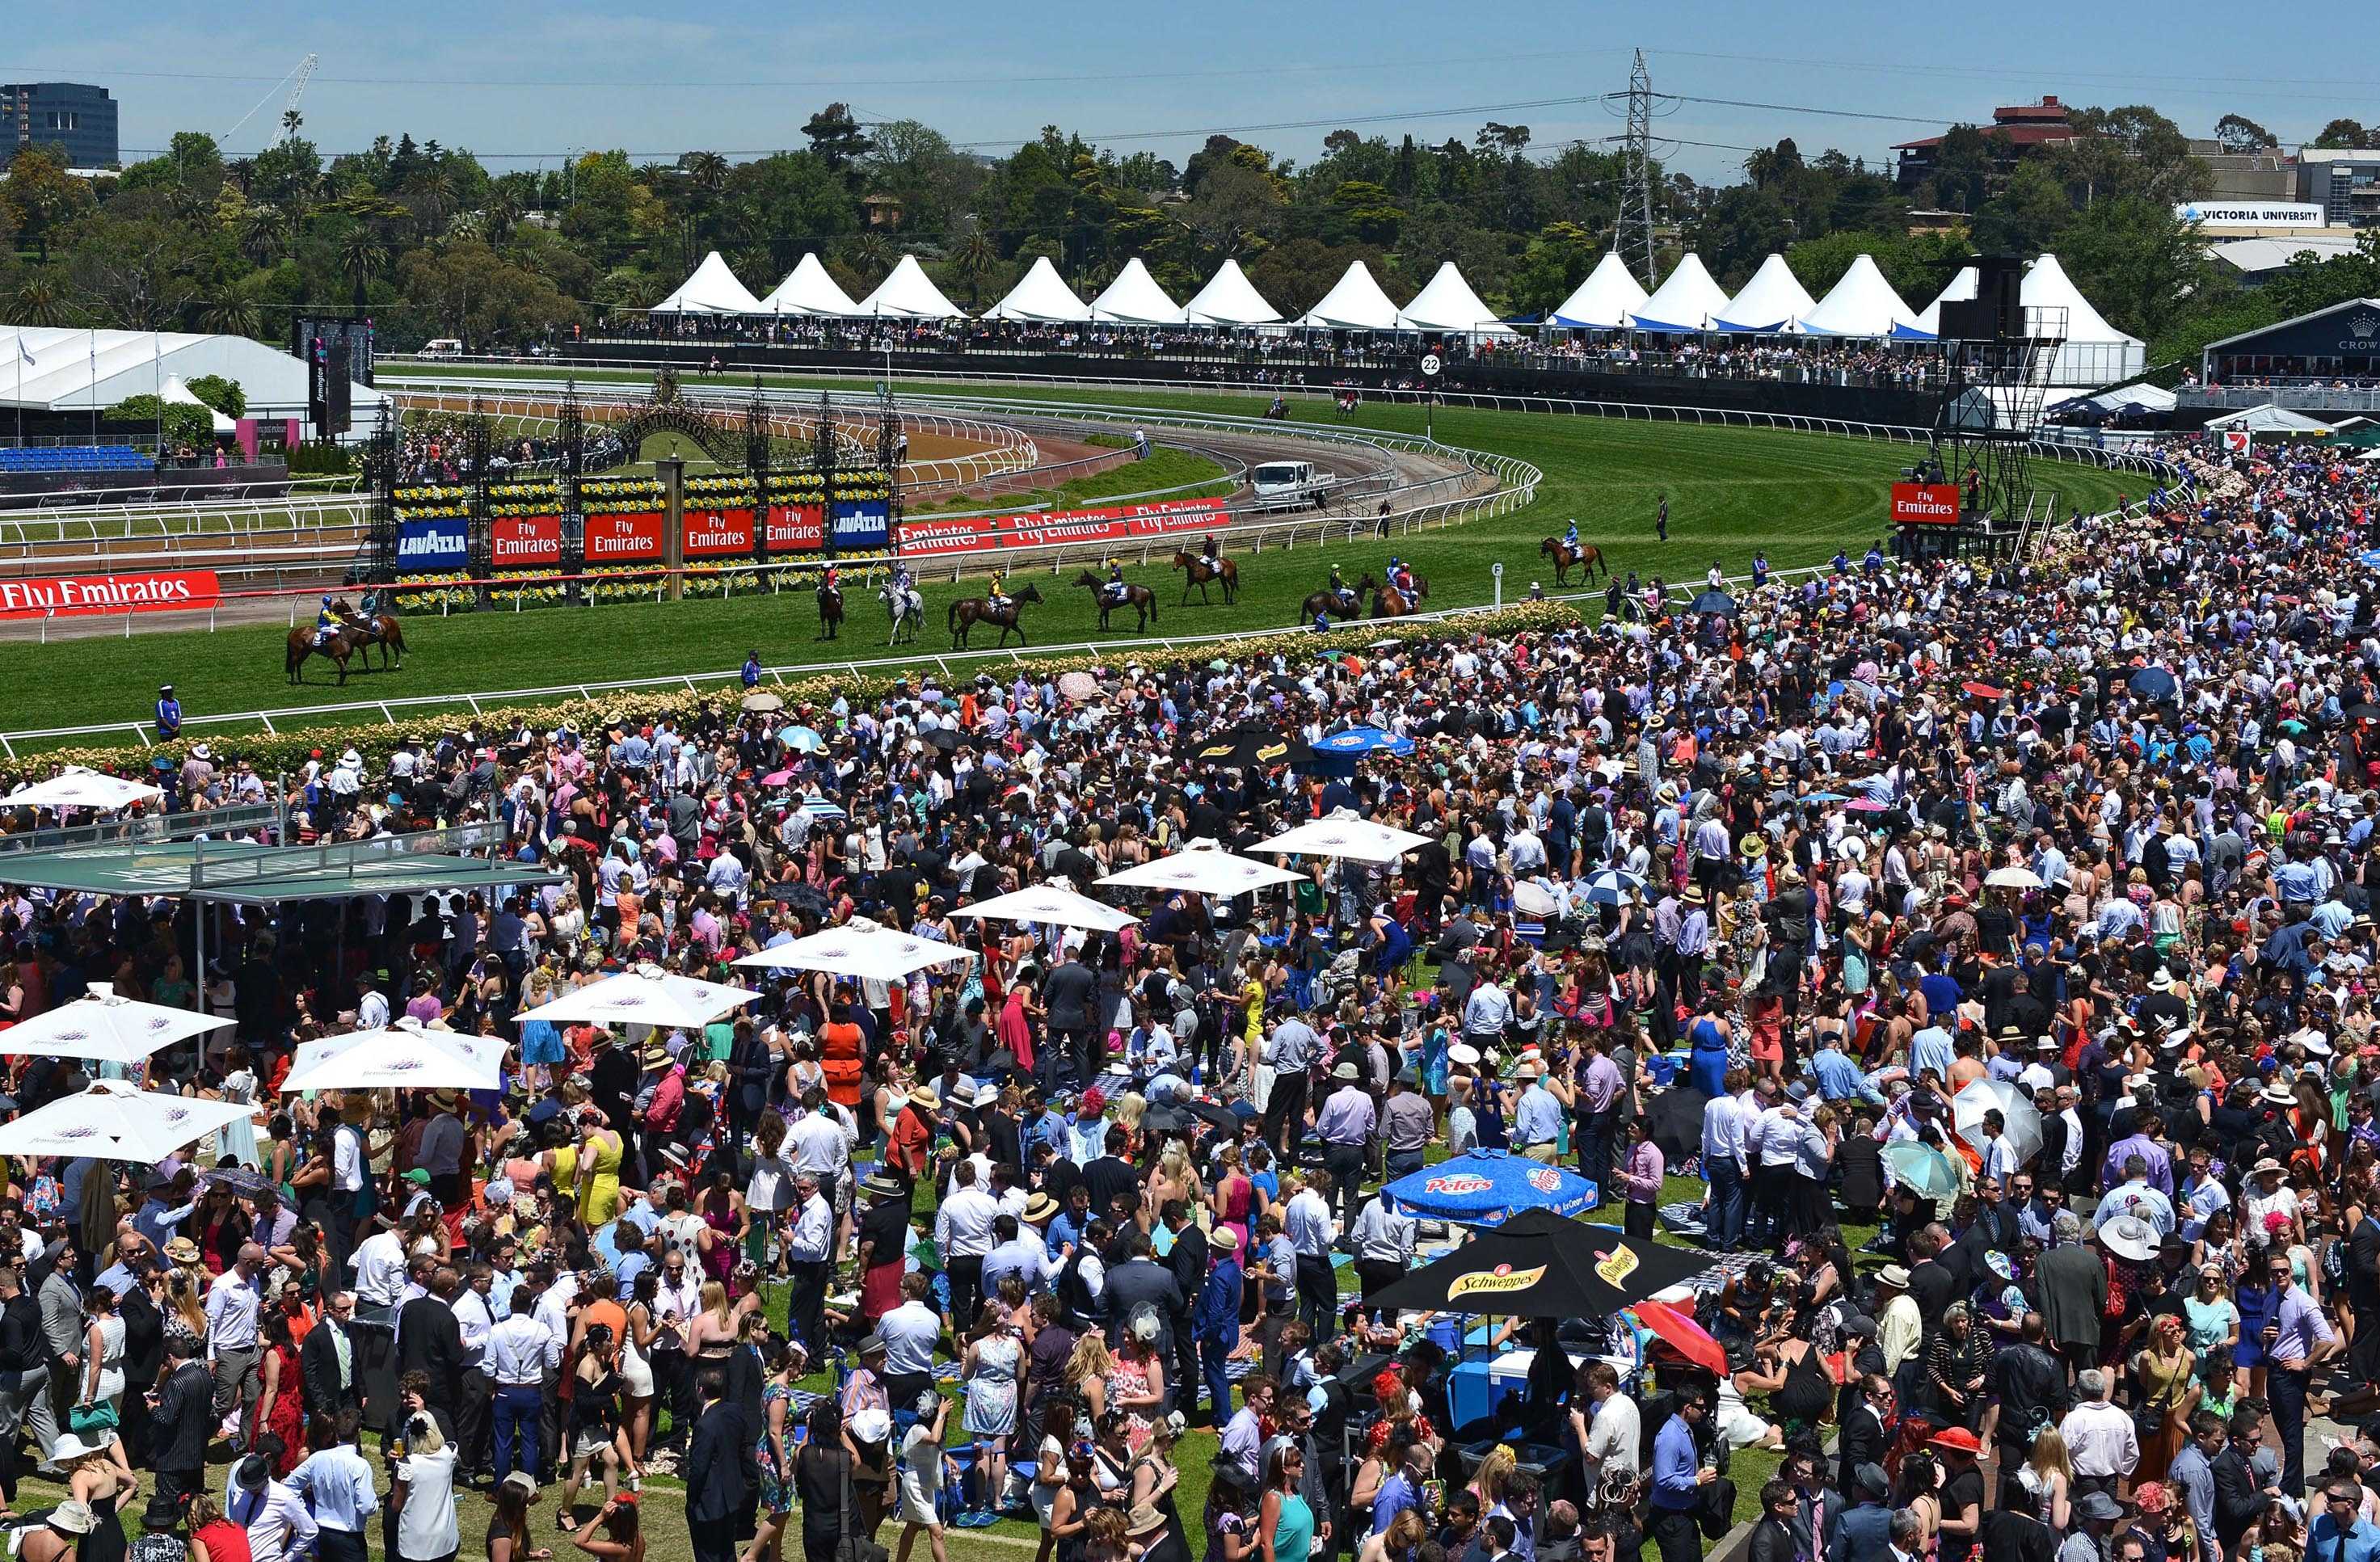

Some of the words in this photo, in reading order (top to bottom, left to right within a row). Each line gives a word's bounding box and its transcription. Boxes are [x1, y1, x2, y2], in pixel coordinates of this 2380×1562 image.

[2204, 210, 2258, 220] VICTORIA
[2263, 211, 2318, 221] UNIVERSITY
[2339, 340, 2380, 350] CROW
[1424, 360, 1438, 369] 22
[1918, 491, 1933, 502] Fly
[1898, 501, 1953, 514] Emirates
[709, 516, 726, 530] Fly
[786, 512, 801, 524] Fly
[1135, 505, 1164, 532] Fly
[518, 523, 536, 537] Fly
[615, 520, 633, 534] Fly
[766, 524, 820, 541] Emirates
[1014, 516, 1044, 543] Fly
[398, 530, 466, 555] LAVAZZA
[496, 537, 558, 554] Emirates
[594, 535, 654, 552] Emirates
[689, 530, 744, 547] Emirates
[1495, 566, 1501, 574] F
[1, 583, 55, 617] Fly
[57, 576, 191, 609] Emirates
[1425, 1178, 1493, 1194] Peters
[1603, 1254, 1633, 1282] Schweppes
[1460, 1274, 1535, 1290] Schweppes
